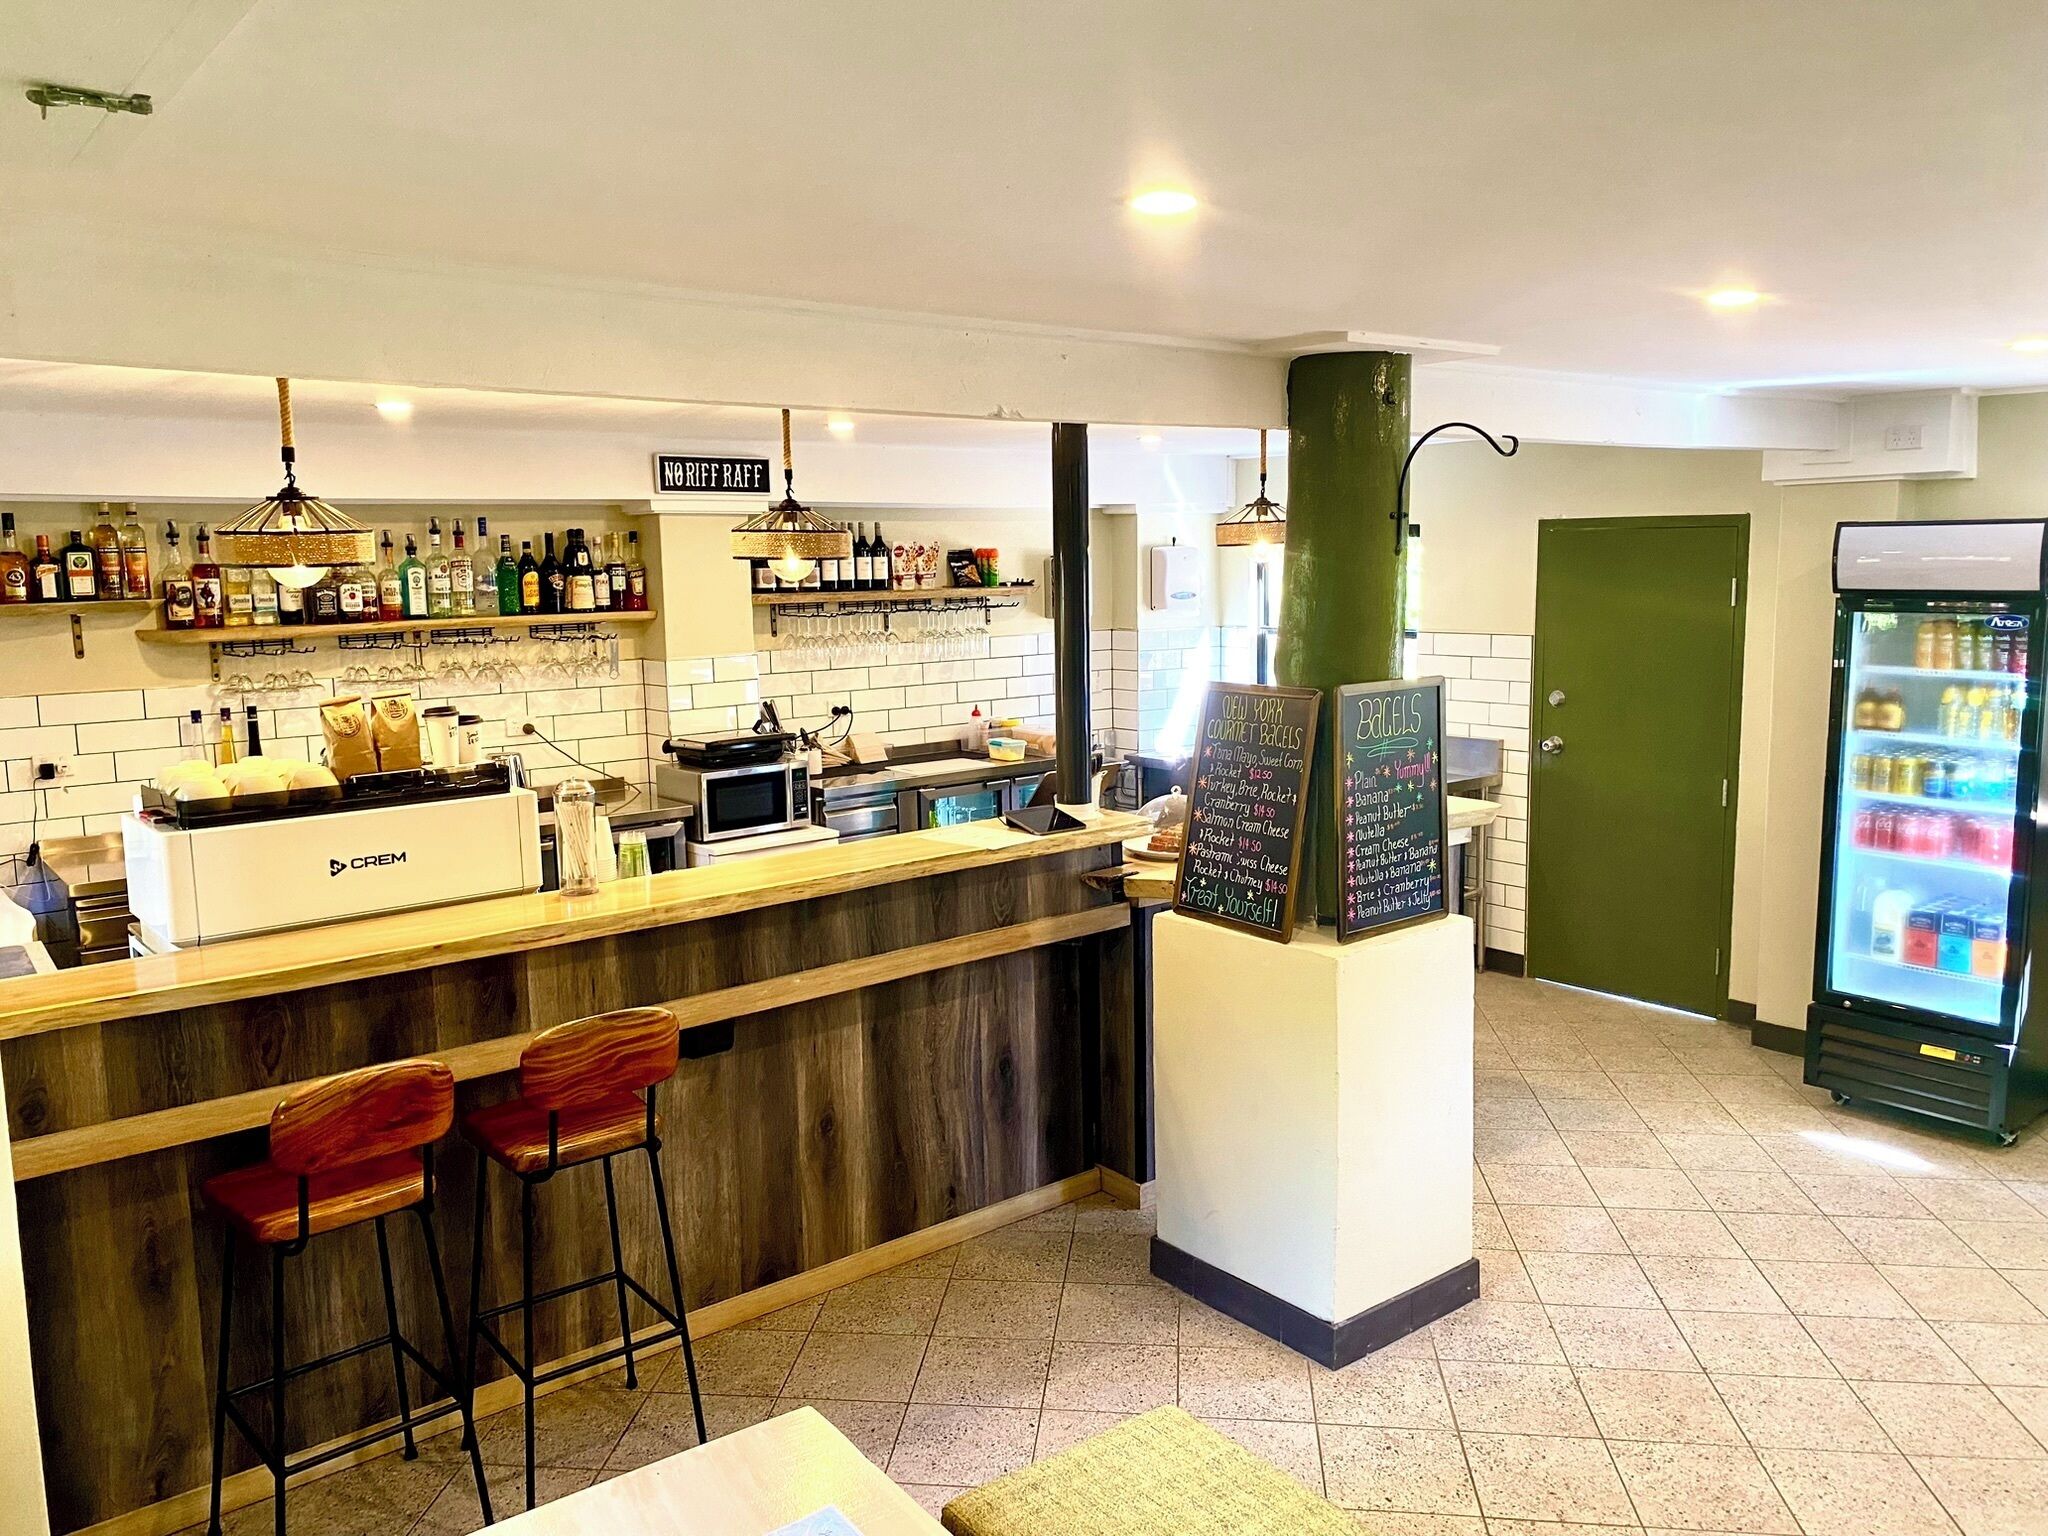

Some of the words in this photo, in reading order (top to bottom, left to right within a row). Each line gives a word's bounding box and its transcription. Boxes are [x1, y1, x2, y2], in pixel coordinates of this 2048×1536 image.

[685, 462, 719, 487] RIFF
[722, 463, 762, 488] RAFF
[8, 573, 20, 581] 43
[1222, 695, 1248, 720] NEW
[1253, 697, 1285, 724] YORK
[1258, 749, 1284, 767] Sweet
[1215, 762, 1242, 779] Rocket
[1354, 770, 1378, 790] Plain
[1204, 791, 1251, 817] Cranberry
[1260, 782, 1292, 805] Rocket
[1354, 790, 1389, 808] Banana
[1200, 806, 1234, 829] Salmon
[1235, 814, 1261, 834] Cream
[1262, 819, 1290, 839] Cheese
[1354, 804, 1382, 826] Peanut
[1382, 801, 1412, 821] Butter
[1203, 827, 1235, 847] Rocket
[1355, 823, 1385, 842] Nutella
[1195, 842, 1233, 865] Pastrami
[1260, 854, 1288, 876] Cheese
[1355, 842, 1380, 858] Cream
[1382, 837, 1409, 852] Cheese
[1355, 853, 1379, 872] Peanut
[1379, 850, 1403, 866] Butter
[1408, 844, 1438, 860] Banana
[351, 851, 407, 869] CREM
[1193, 858, 1222, 878] Rocket
[1355, 868, 1384, 887] Nutella
[1389, 860, 1421, 879] Banana
[1185, 875, 1219, 909] Treat
[1356, 890, 1375, 903] Brie
[1383, 877, 1430, 896] Cranberry
[1357, 899, 1382, 920] Peanut
[1382, 896, 1407, 914] Butter
[1412, 889, 1431, 911] Jelly
